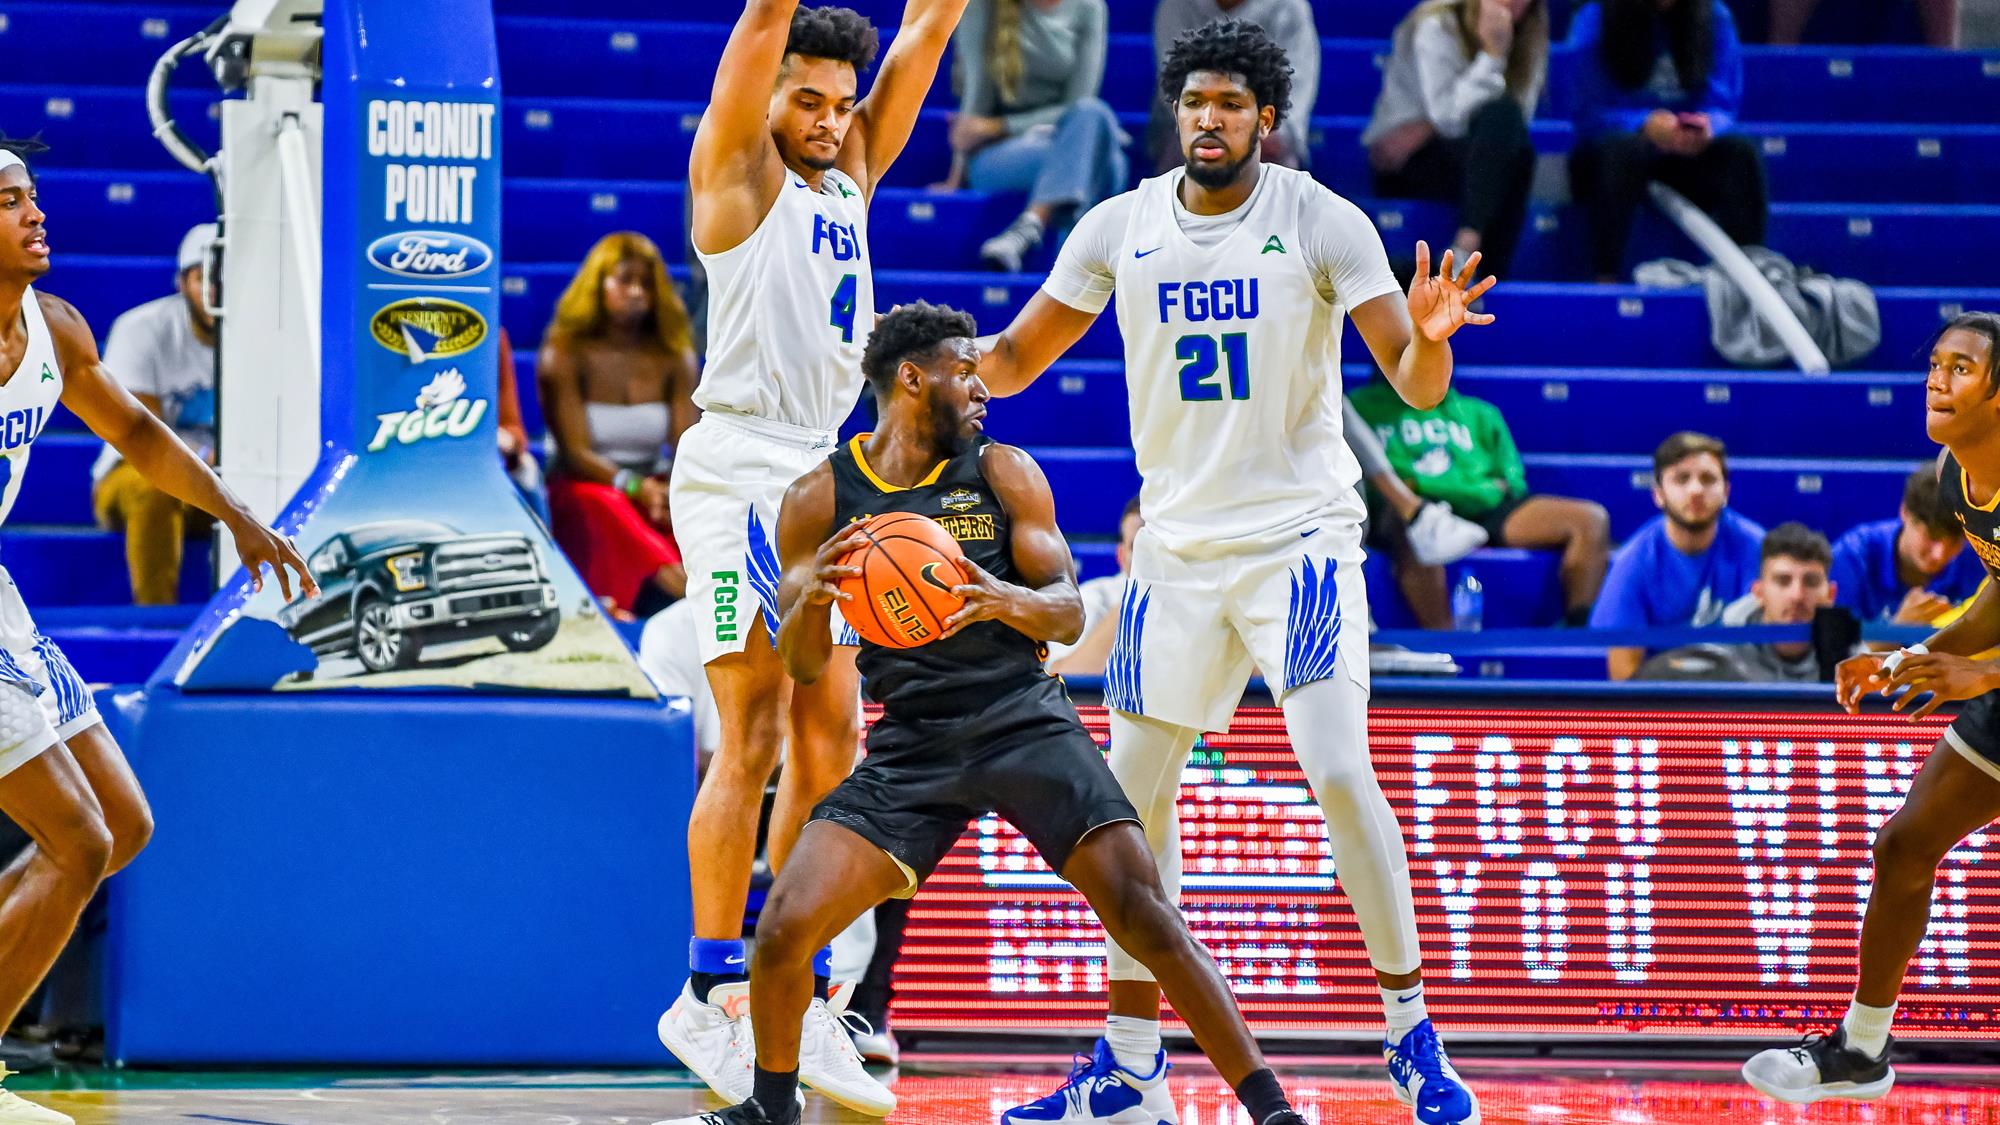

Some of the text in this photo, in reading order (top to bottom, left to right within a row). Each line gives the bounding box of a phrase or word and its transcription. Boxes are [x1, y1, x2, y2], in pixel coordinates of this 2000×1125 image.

[368, 99, 495, 160] COCONUT
[385, 163, 477, 224] POINT
[390, 236, 469, 272] Ford
[829, 273, 858, 344] 4
[1158, 277, 1259, 323] FGCU
[1175, 331, 1251, 401] 21
[0, 406, 44, 451] CU
[367, 398, 488, 452] FGCU
[711, 570, 740, 642] FGCU
[884, 586, 932, 642] ELITE
[1411, 735, 1663, 857] FGCU
[1721, 739, 1988, 863] WIN
[1432, 861, 1656, 983] YOU
